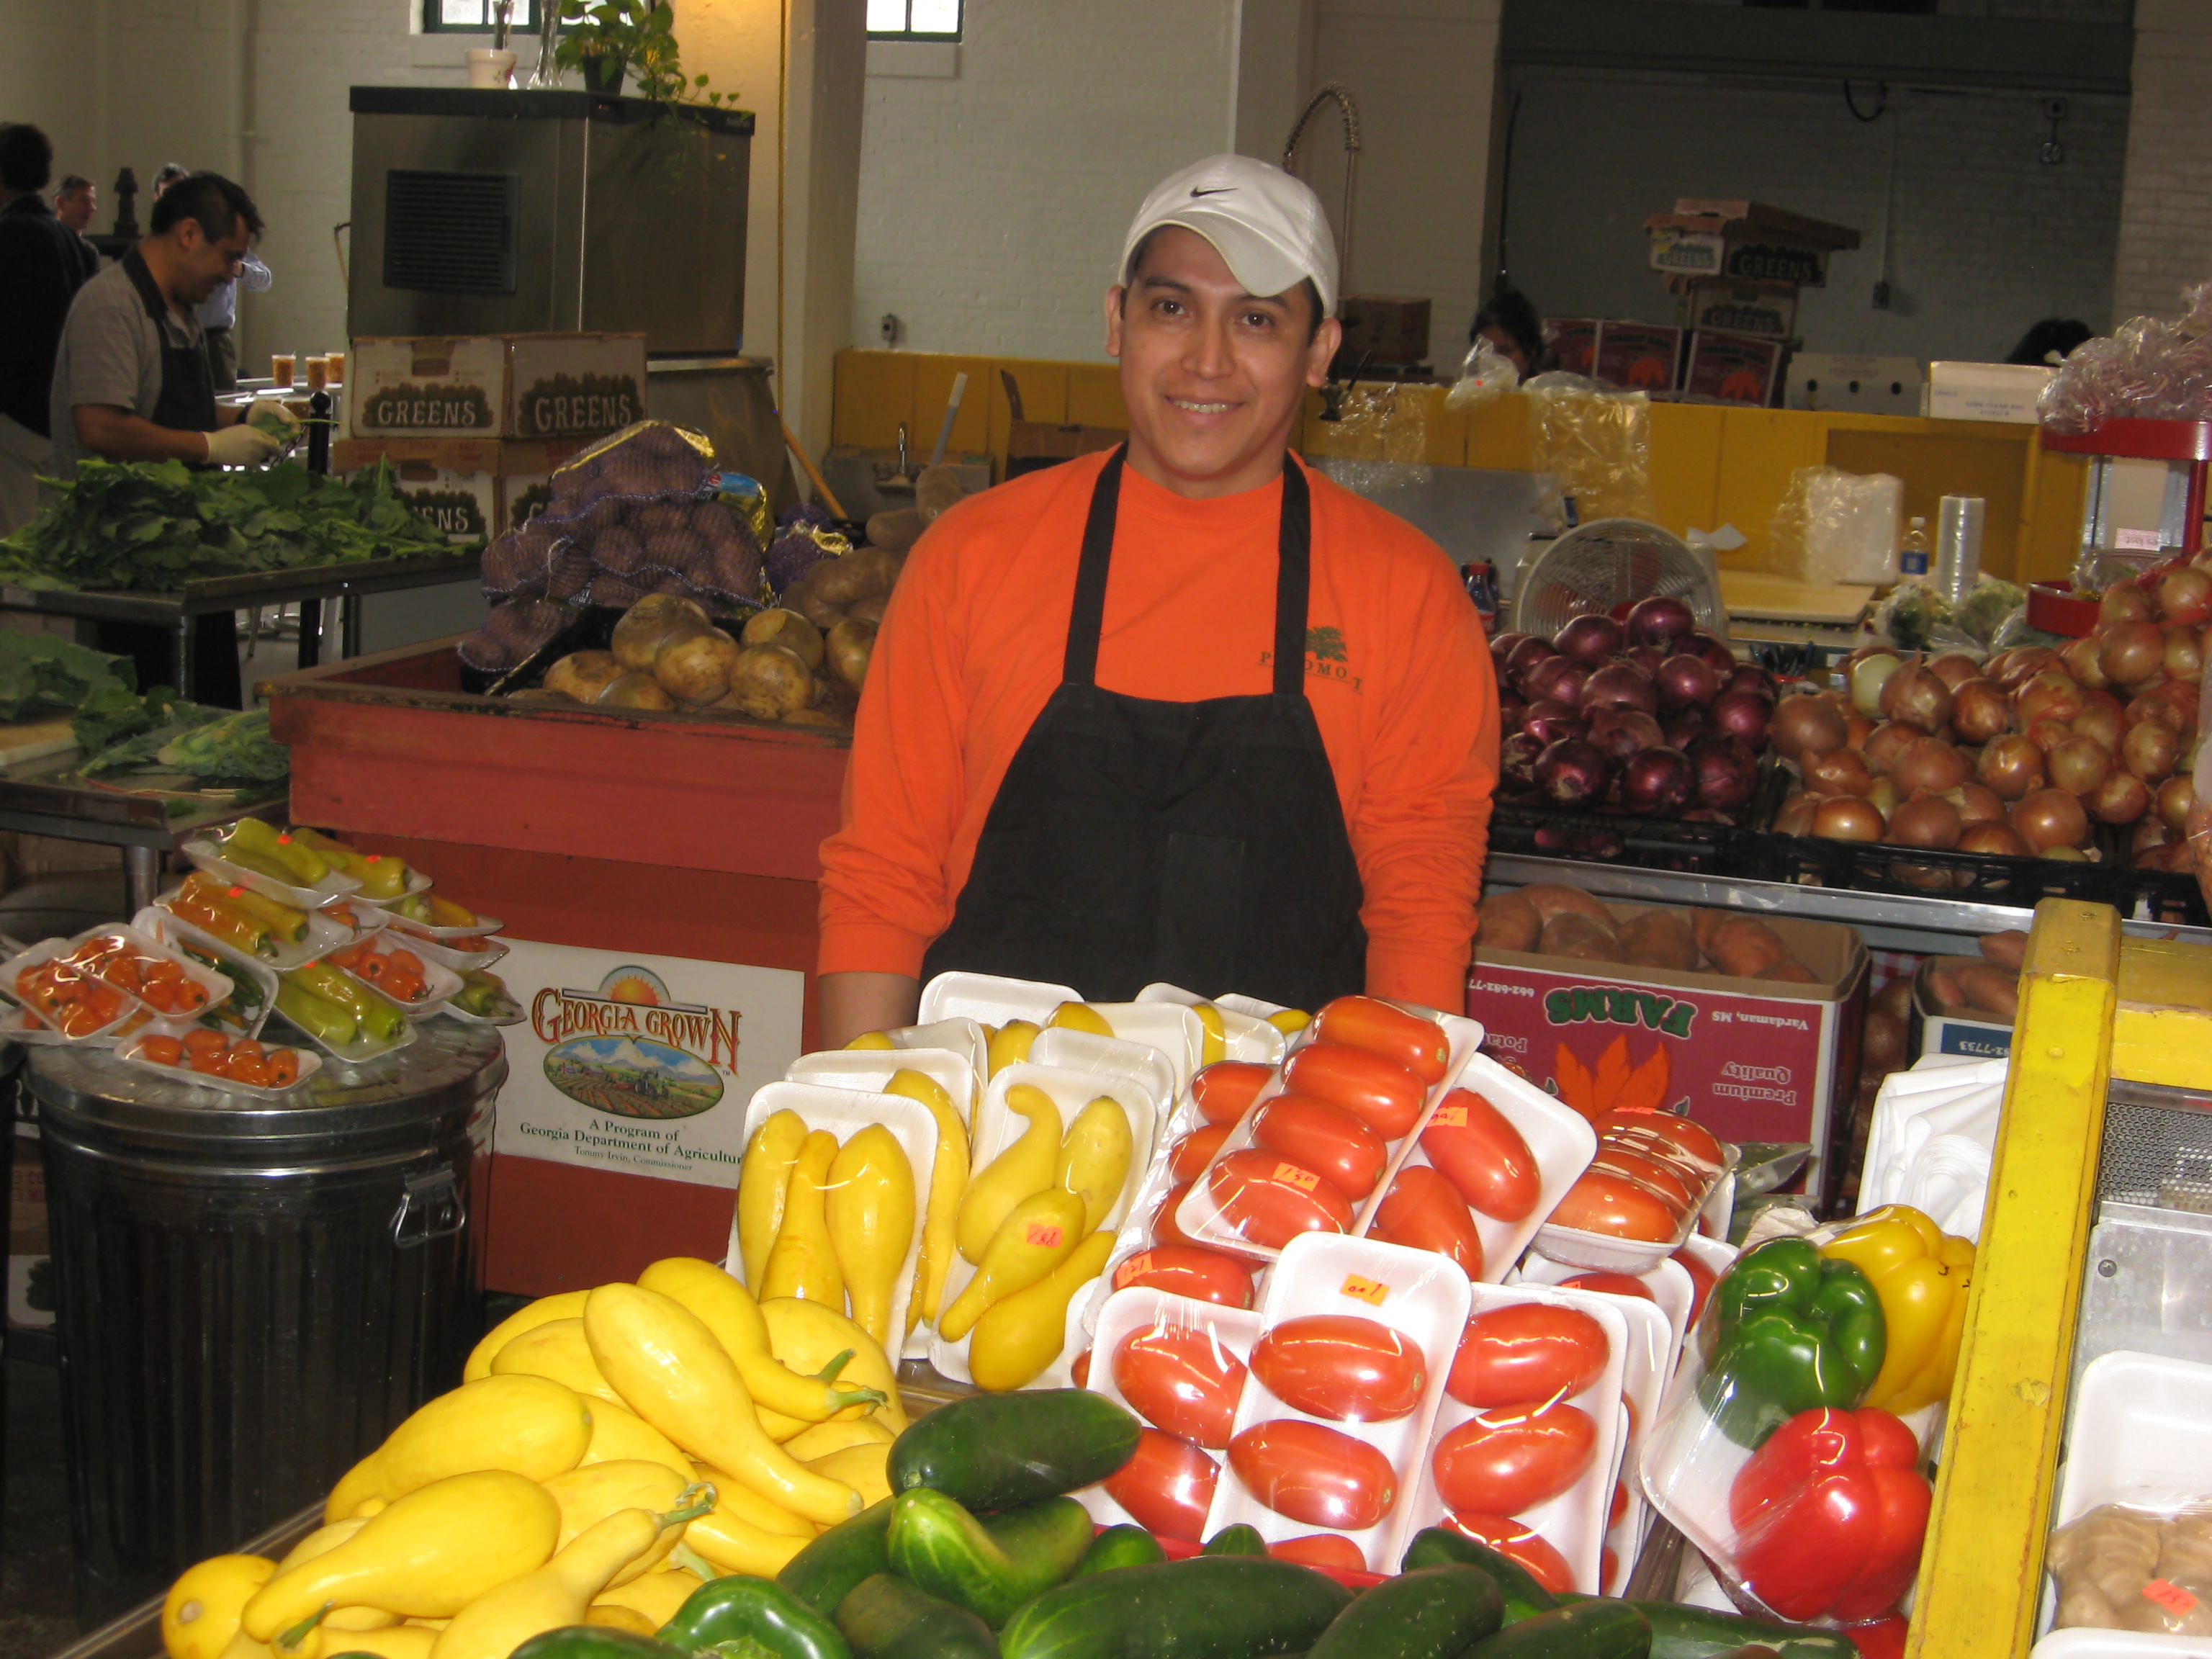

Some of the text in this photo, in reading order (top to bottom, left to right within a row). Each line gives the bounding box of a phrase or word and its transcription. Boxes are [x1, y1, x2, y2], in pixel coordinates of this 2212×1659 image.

[1663, 251, 1711, 268] GREENS
[1739, 254, 1812, 282] GREENS
[1710, 311, 1776, 332] GREENS
[377, 399, 477, 426] GREENS
[534, 394, 632, 432] GREENS
[1468, 978, 1535, 998] 662-682-77
[1544, 985, 1699, 1040] FARMS
[1712, 1010, 1809, 1031] Vardaman, MS
[531, 987, 743, 1077] GEORGIA GROWN
[1722, 1061, 1792, 1084] Quality
[1713, 1081, 1797, 1106] Premium
[589, 1118, 680, 1142] A Program of
[519, 1122, 742, 1165] Georgia Department of Agricultur
[575, 1146, 604, 1159] Tommy
[633, 1155, 693, 1172] Commissioner
